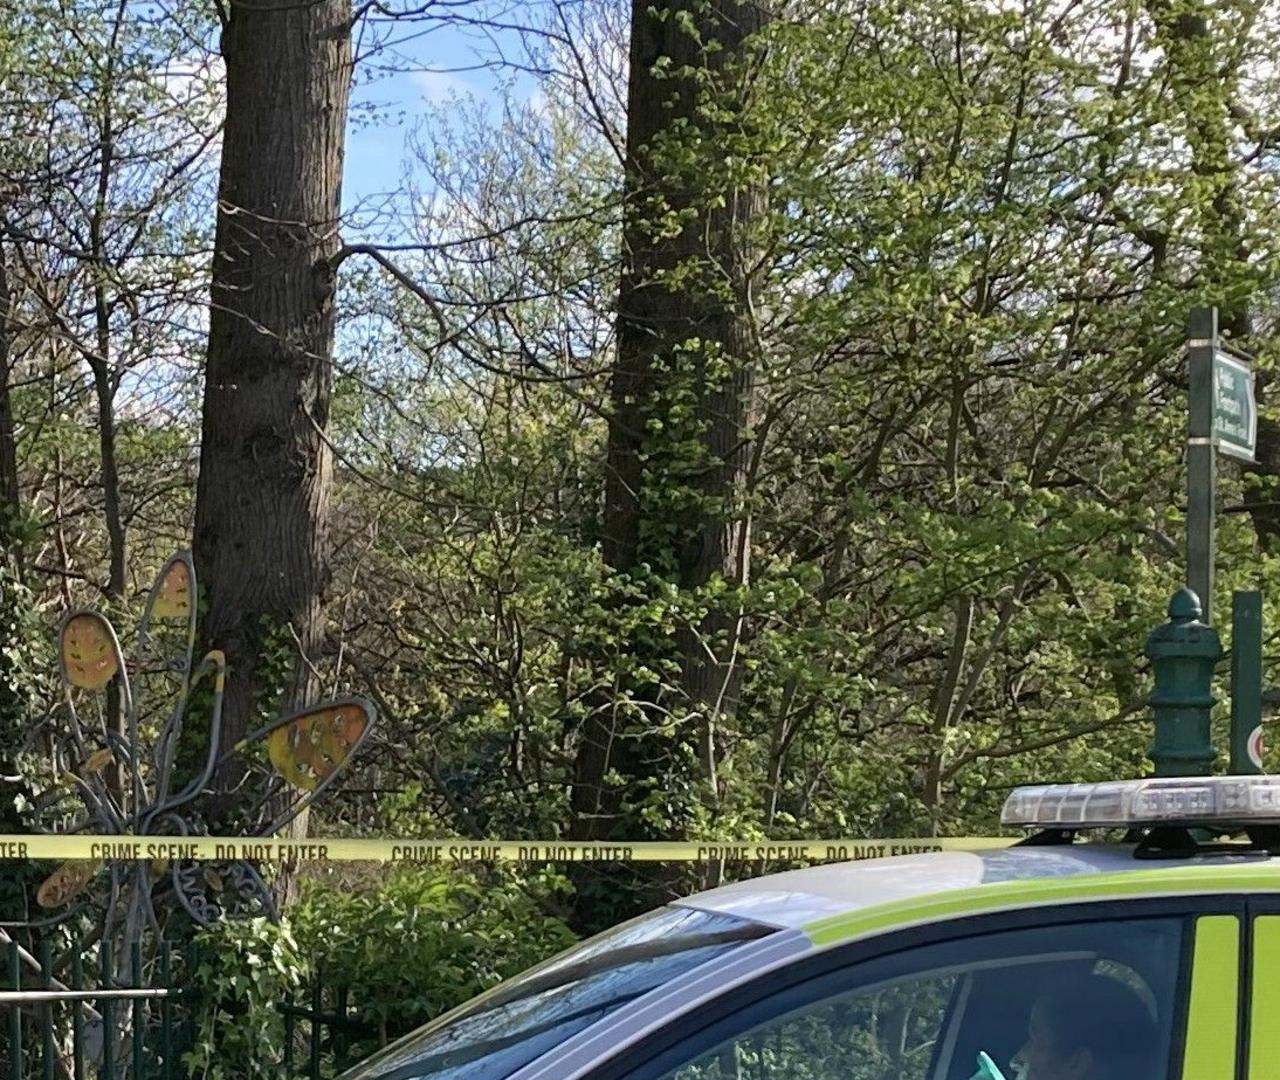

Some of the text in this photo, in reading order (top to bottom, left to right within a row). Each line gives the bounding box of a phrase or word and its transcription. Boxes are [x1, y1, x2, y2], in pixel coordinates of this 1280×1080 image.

[91, 843, 141, 860] CRIME
[215, 844, 236, 860] DO
[241, 844, 273, 860] NOT
[278, 845, 329, 861] ENTER
[391, 845, 442, 861] CRIME
[518, 847, 539, 861] DO
[545, 847, 577, 861] NOT
[581, 847, 633, 861] ENTER
[826, 846, 848, 860] DO
